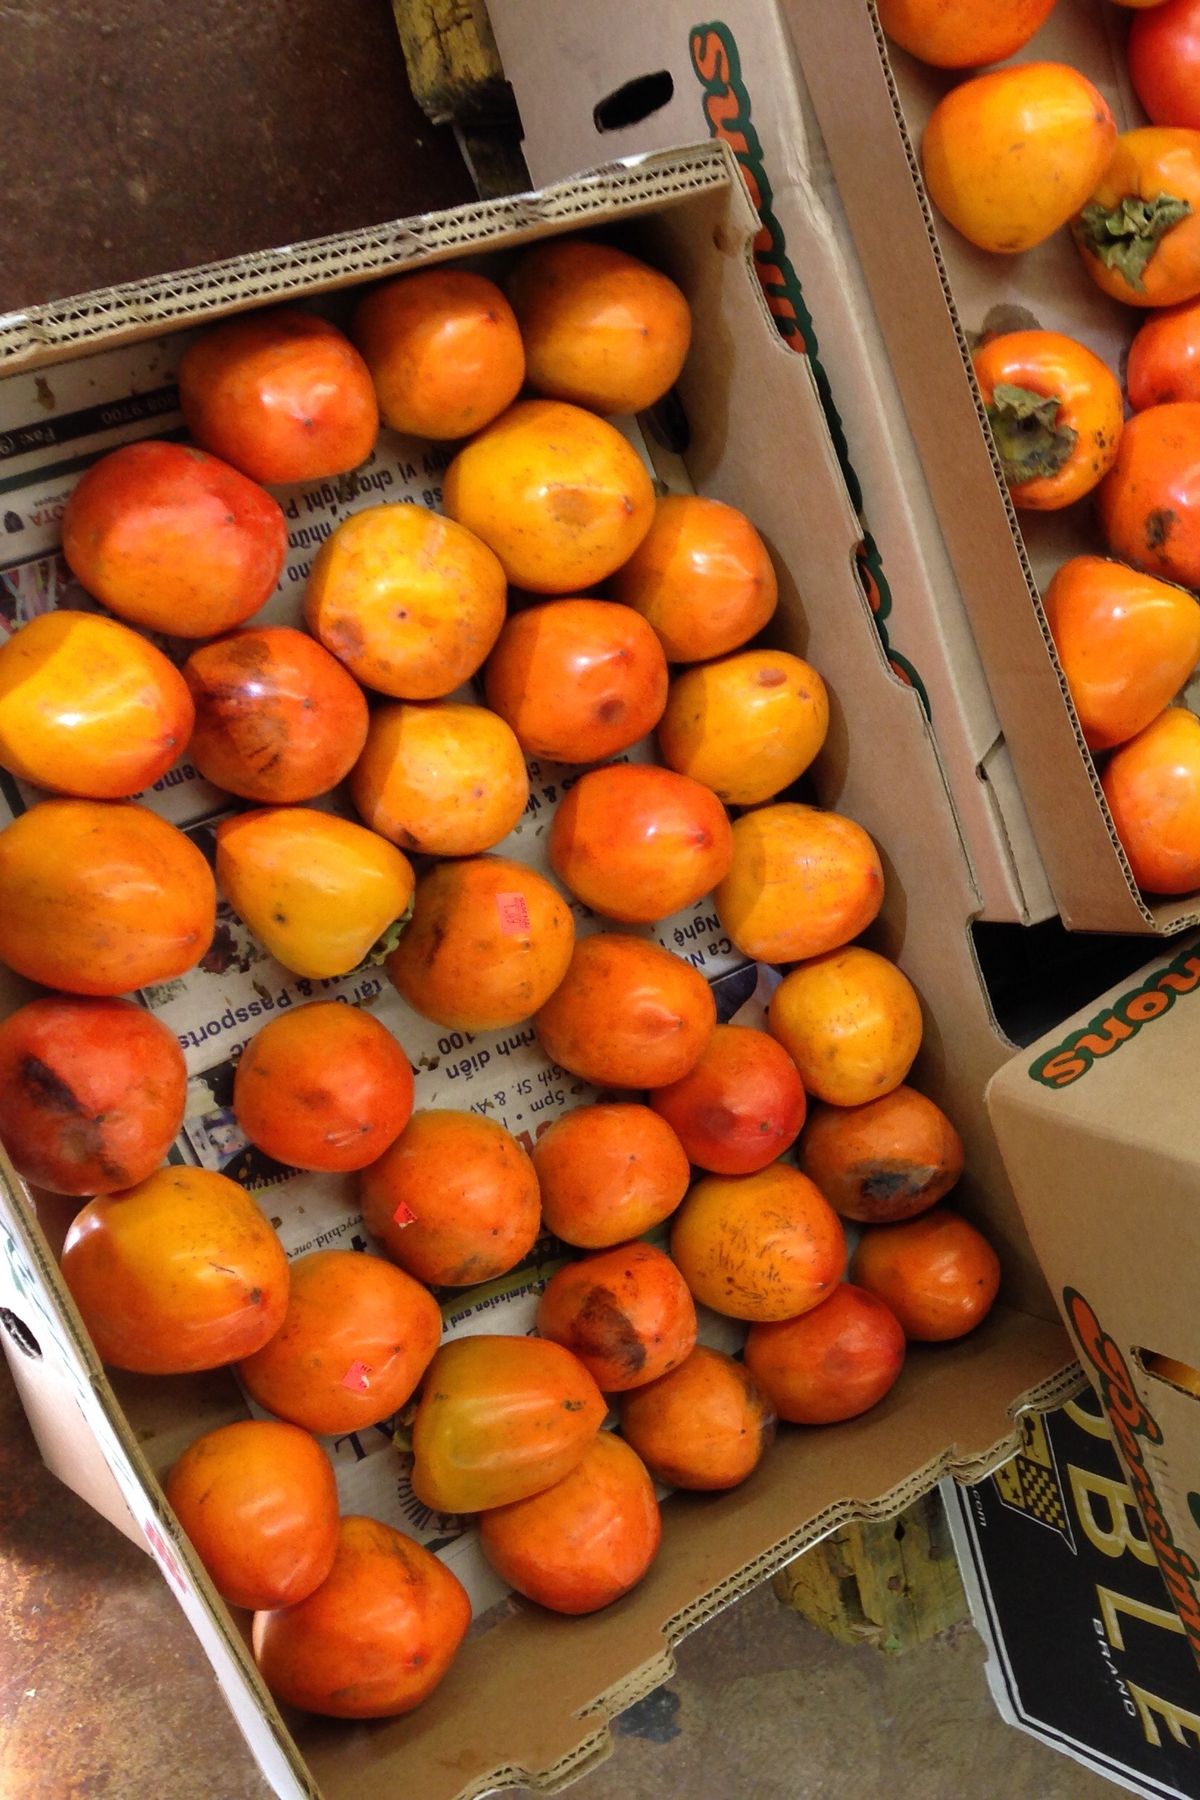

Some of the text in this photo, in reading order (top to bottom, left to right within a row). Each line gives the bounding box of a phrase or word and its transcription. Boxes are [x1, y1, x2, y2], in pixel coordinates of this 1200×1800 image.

[359, 469, 394, 492] cho
[28, 505, 65, 527] OTA
[288, 522, 332, 549] nhữn
[673, 914, 721, 946] Nghệ
[707, 938, 732, 956] Ca
[296, 979, 313, 997] &
[178, 988, 292, 1049] Passports
[446, 1028, 537, 1081] rình diễn
[512, 1079, 533, 1095] St.
[537, 1064, 570, 1089] 5th
[493, 1090, 506, 1106] &
[529, 1090, 565, 1113] 5pm
[450, 1306, 472, 1328] and
[1092, 1618, 1136, 1717] BRAND
